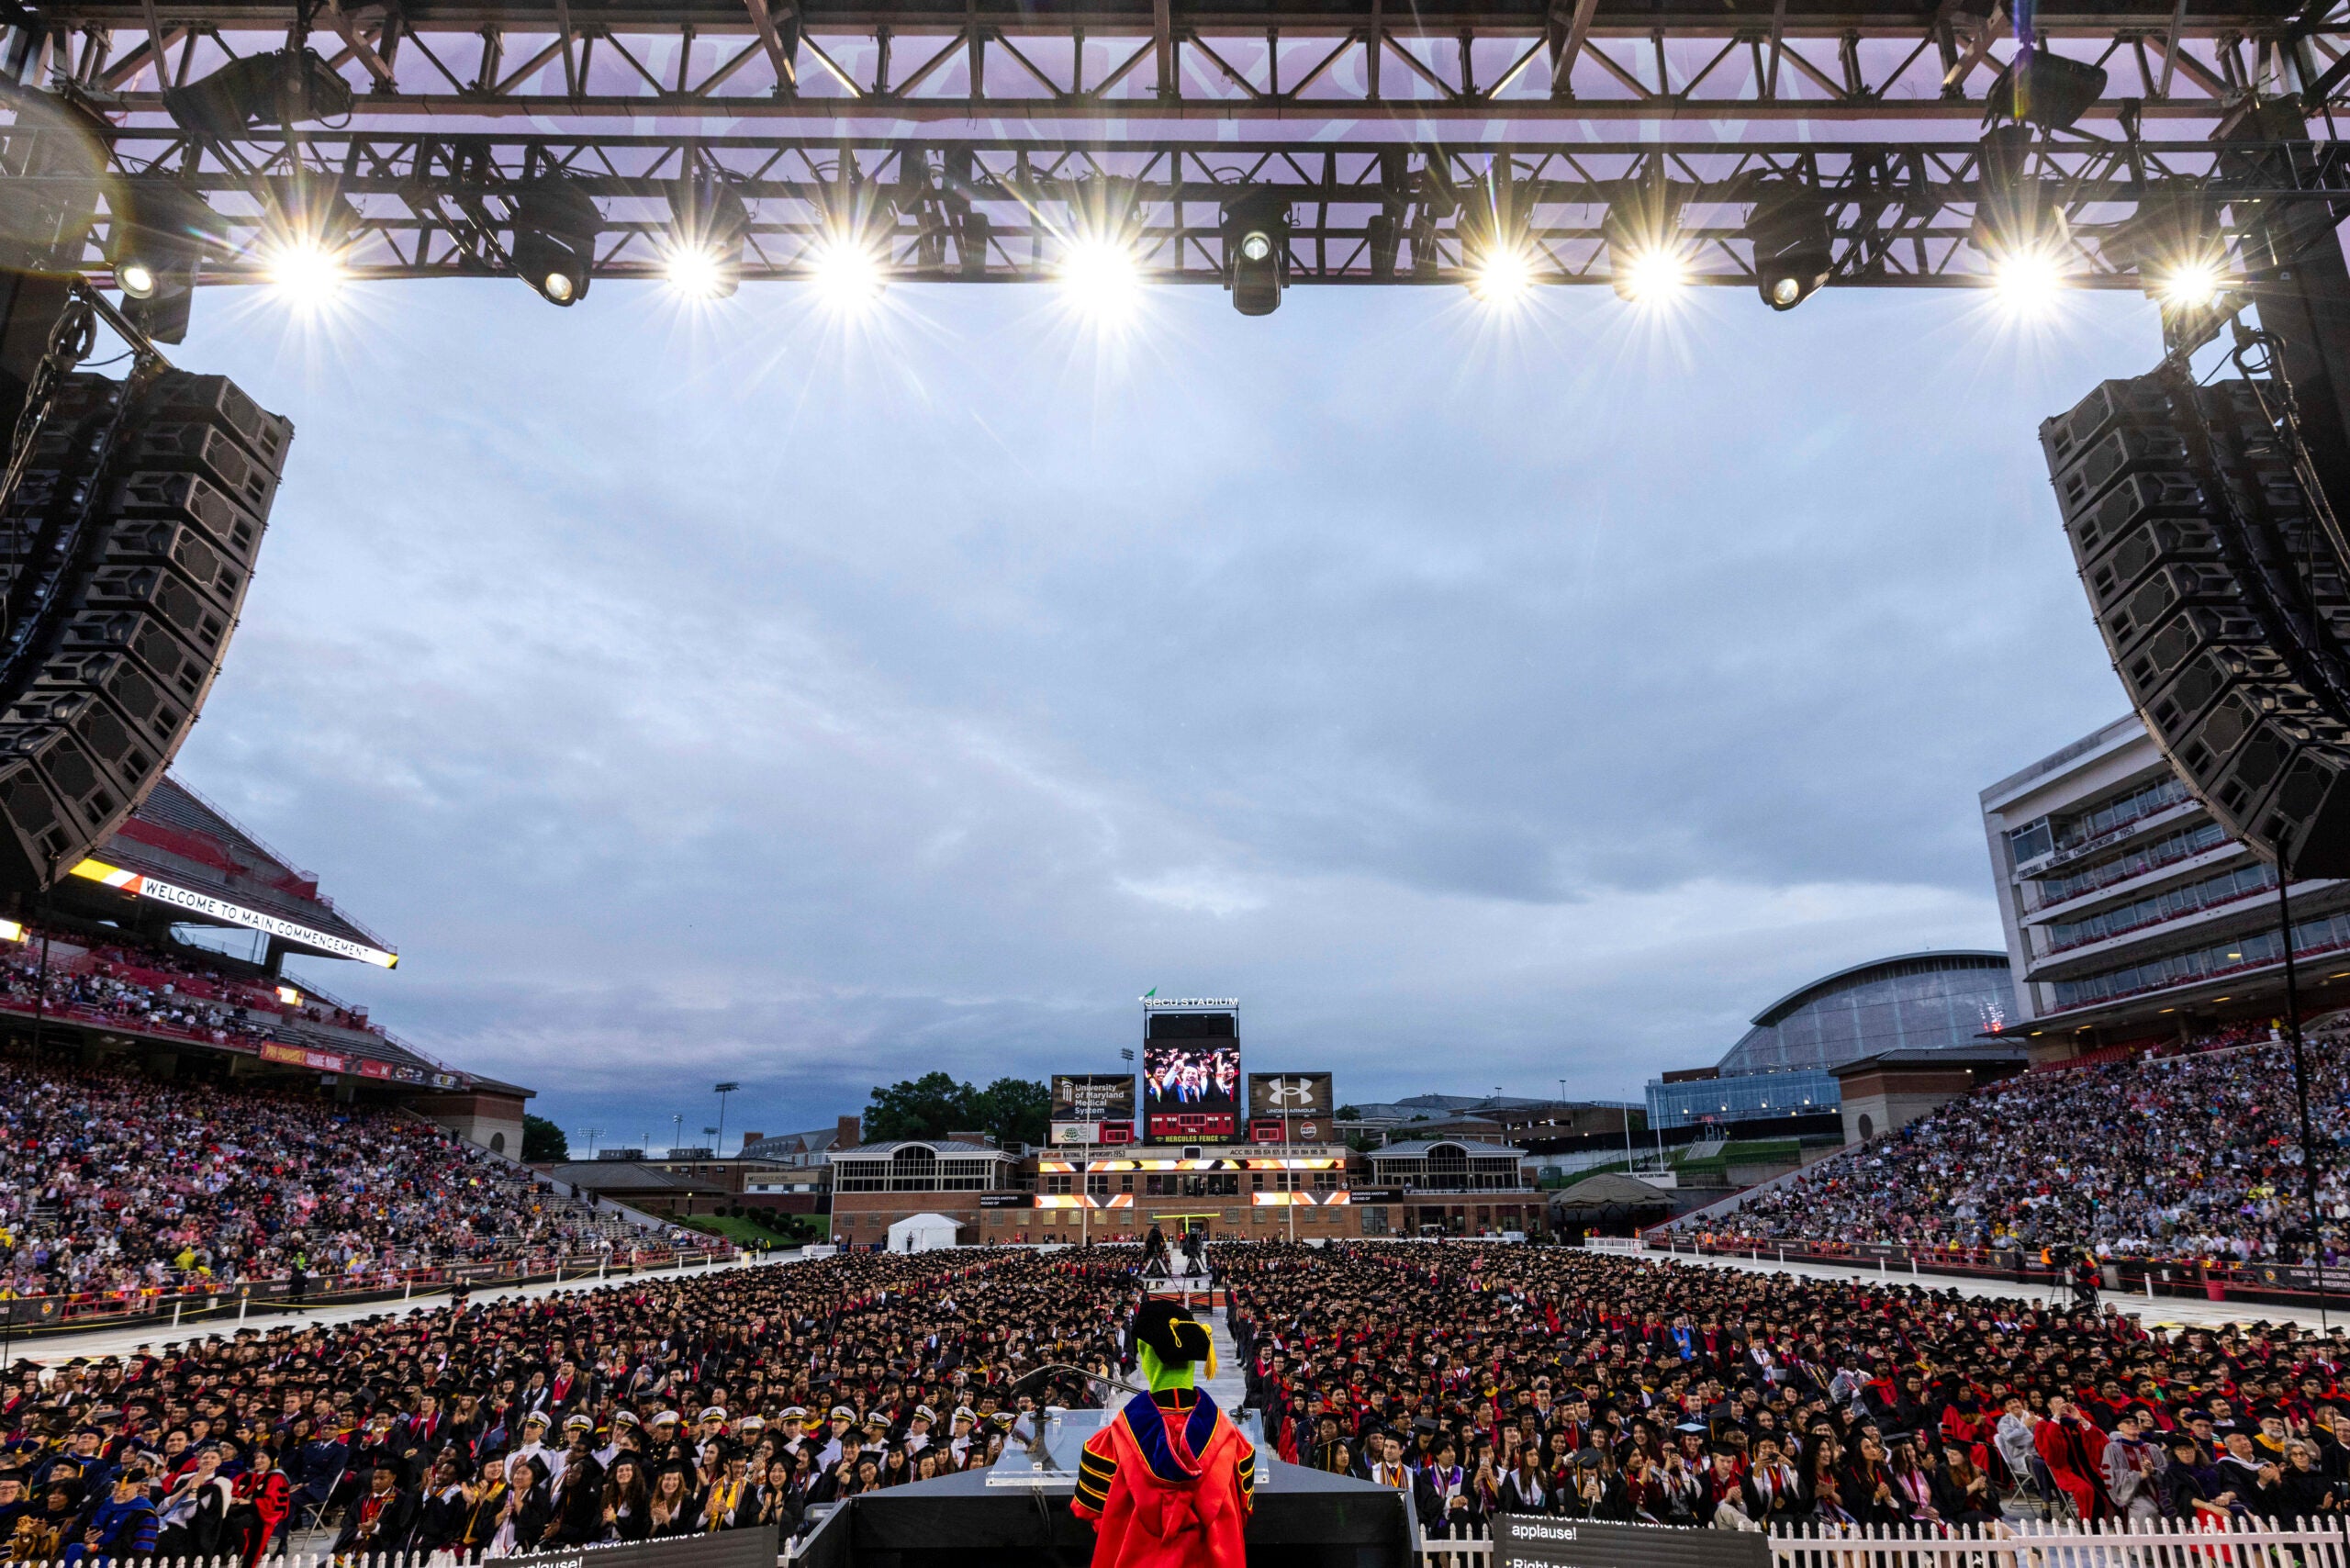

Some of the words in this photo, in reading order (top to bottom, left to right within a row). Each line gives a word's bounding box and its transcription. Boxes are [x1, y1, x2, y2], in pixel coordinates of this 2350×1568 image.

[2120, 826, 2135, 838] 1953
[145, 880, 216, 913] WELCOME
[221, 903, 237, 919] TO
[241, 910, 273, 930] MAIN
[277, 922, 369, 958] COMMENCEMENT
[1181, 997, 1239, 1006] STADIUM
[1075, 1084, 1117, 1092] University
[1086, 1092, 1125, 1100] Maryland
[1512, 1524, 1577, 1540] applause!
